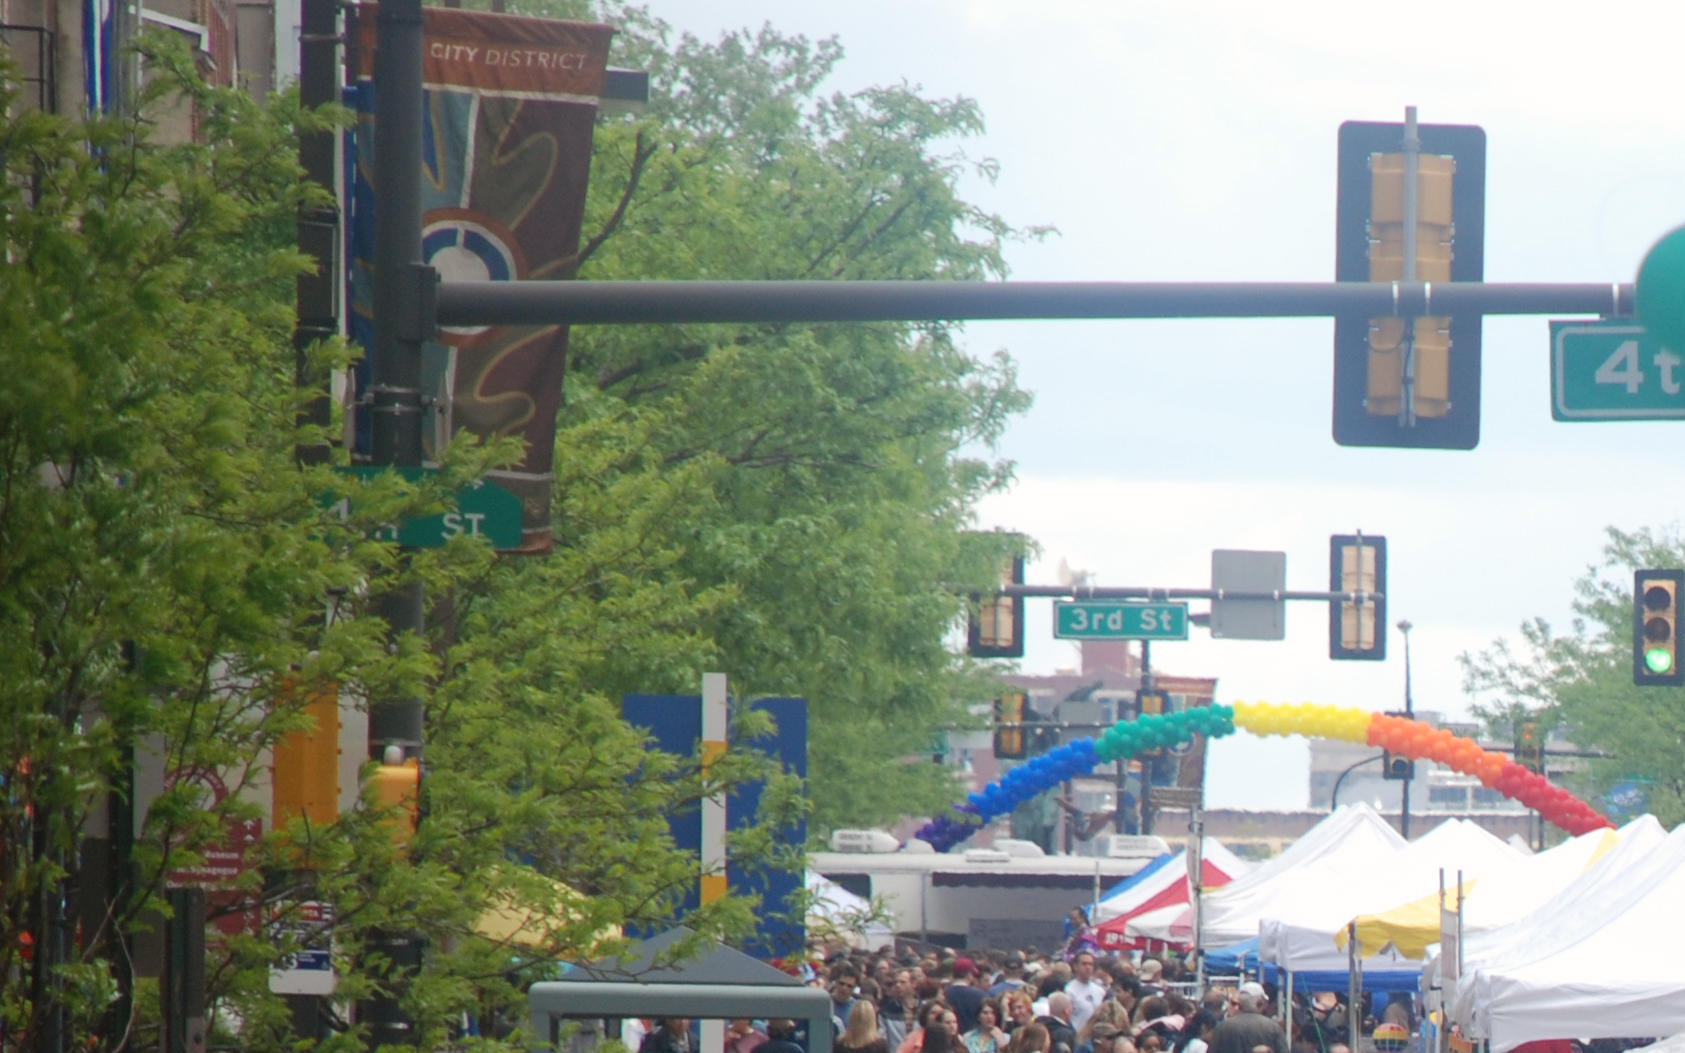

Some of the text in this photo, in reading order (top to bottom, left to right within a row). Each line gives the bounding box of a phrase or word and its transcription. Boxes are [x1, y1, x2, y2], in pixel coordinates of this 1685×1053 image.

[430, 42, 588, 70] CITY DISTRICT
[440, 513, 486, 540] ST
[1070, 608, 1173, 631] 3rd St
